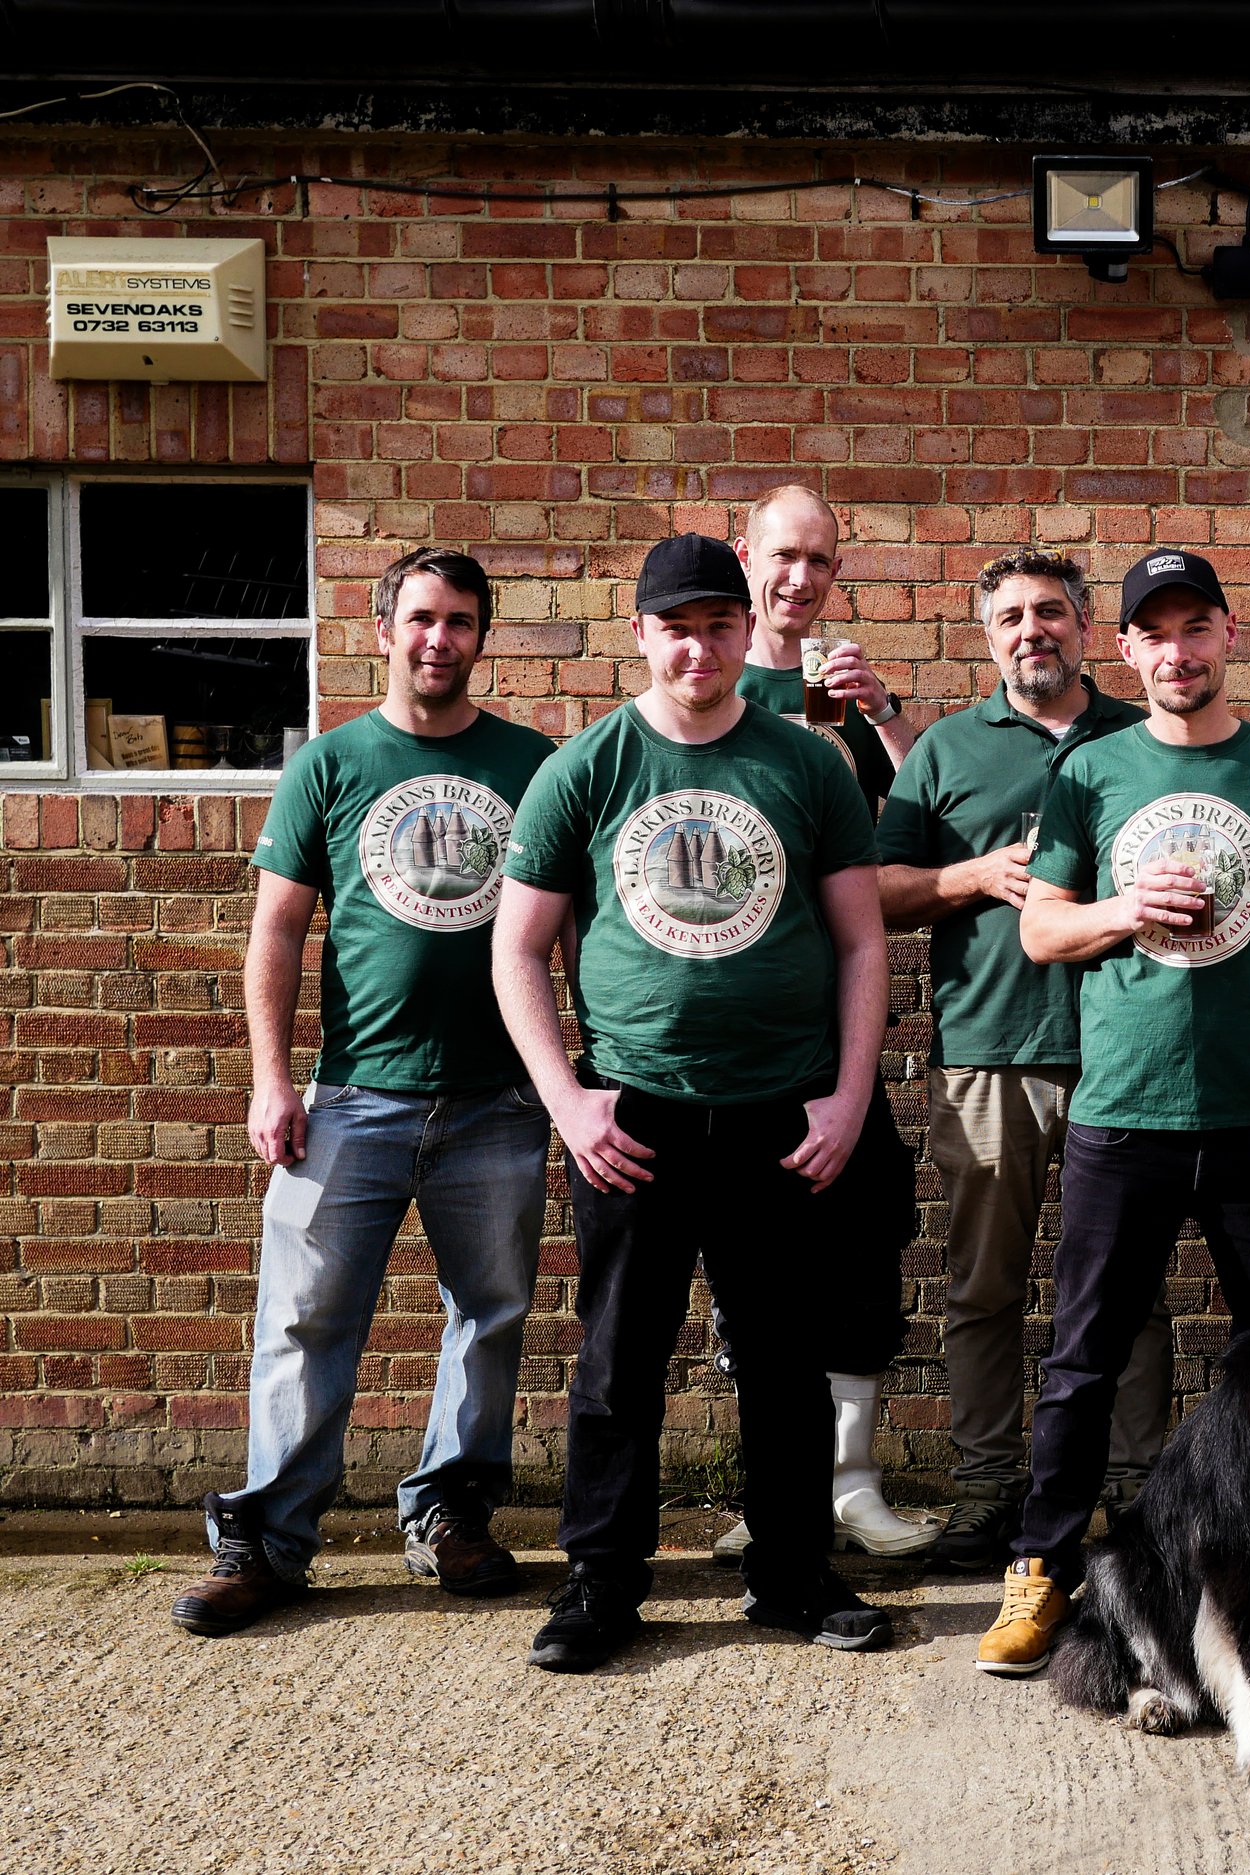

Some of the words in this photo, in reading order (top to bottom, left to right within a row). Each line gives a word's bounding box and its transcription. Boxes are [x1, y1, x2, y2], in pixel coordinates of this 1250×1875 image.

[127, 278, 211, 290] SYSTEMS
[67, 303, 203, 316] SEVENOAKS
[73, 320, 129, 332] 0732
[138, 321, 198, 333] 63113
[370, 784, 436, 858] LARKINS
[624, 799, 695, 877] LARKINS
[699, 800, 776, 879] BREWERY
[1119, 803, 1185, 887] LARKINS
[381, 873, 410, 908] REAL
[414, 899, 484, 918] KENTISH
[634, 894, 662, 932] REAL
[665, 924, 740, 945] KENTISH
[742, 894, 768, 931] ALES
[1160, 932, 1227, 954] KENTISH
